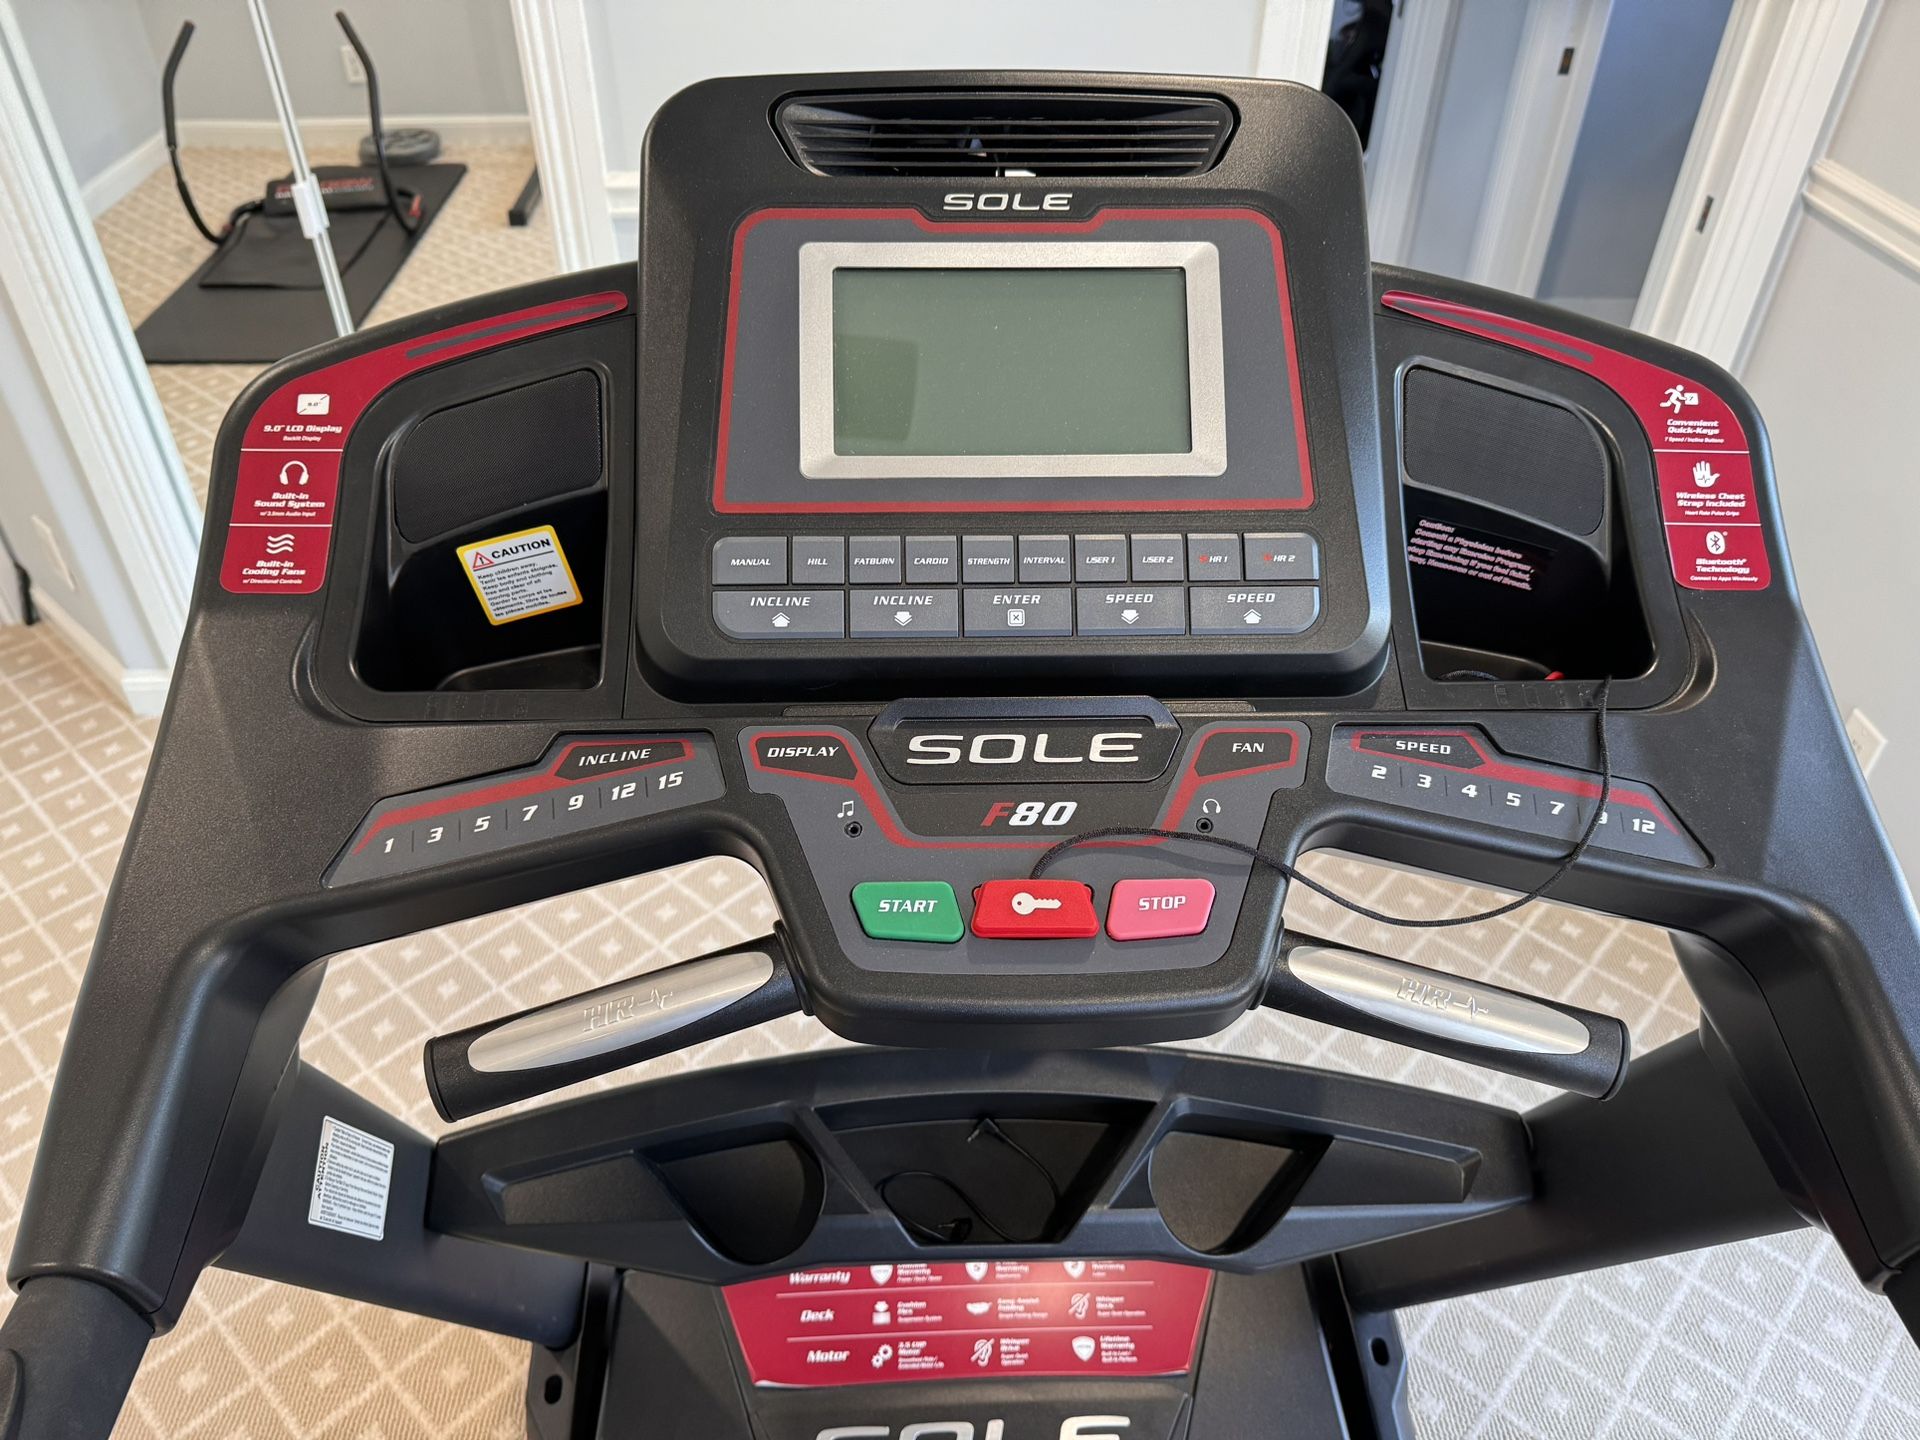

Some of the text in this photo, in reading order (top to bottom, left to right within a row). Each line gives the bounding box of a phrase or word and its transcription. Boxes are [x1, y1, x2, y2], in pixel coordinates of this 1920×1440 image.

[943, 192, 1073, 211] SOLE
[1667, 418, 1719, 427] Convenient
[306, 425, 343, 434] Display
[1668, 426, 1720, 435] Quick-Keys
[272, 492, 309, 500] Built-in
[1718, 492, 1745, 500] Chest
[287, 500, 326, 509] System
[1677, 499, 1704, 508] Strap
[491, 538, 551, 559] CAUTION
[730, 558, 771, 566] MANUAL
[807, 558, 828, 566] HILL
[854, 557, 895, 565] FATBURN
[913, 557, 949, 565] CARDIO
[967, 558, 1010, 566] STRENGTH
[1023, 556, 1066, 564] INTERVAL
[1086, 556, 1108, 564] USER
[1142, 556, 1165, 564] USER
[1209, 555, 1228, 563] HR 1
[1273, 554, 1296, 562] HR 2
[256, 560, 294, 568] Built-in
[242, 568, 280, 576] Cooling
[1696, 566, 1750, 574] Technology
[750, 596, 811, 607] INCLINE
[873, 595, 933, 606] INCLINE
[992, 594, 1041, 605] ENTER
[1105, 593, 1154, 604] SPEED
[1226, 593, 1276, 603] SPEED
[767, 744, 839, 759] DISPLAY
[906, 732, 1143, 766] SOLE
[1232, 741, 1265, 754] FAN
[1395, 740, 1451, 755] SPEED
[578, 748, 652, 767] INCLINE
[1371, 765, 1387, 780] 2
[1417, 774, 1432, 789] 3
[1461, 784, 1478, 798] 4
[1505, 792, 1522, 807] 5
[1549, 801, 1565, 816] 7
[1632, 817, 1656, 835] 12
[384, 771, 684, 854] 1 3 5 7 9 12 15
[980, 800, 1078, 827] F80
[878, 898, 939, 913] START
[1138, 894, 1187, 910] STOP
[315, 1145, 325, 1192] CAUTION
[789, 1271, 851, 1285] Warranty
[800, 1308, 834, 1323] Deck
[807, 1350, 850, 1363] Motor
